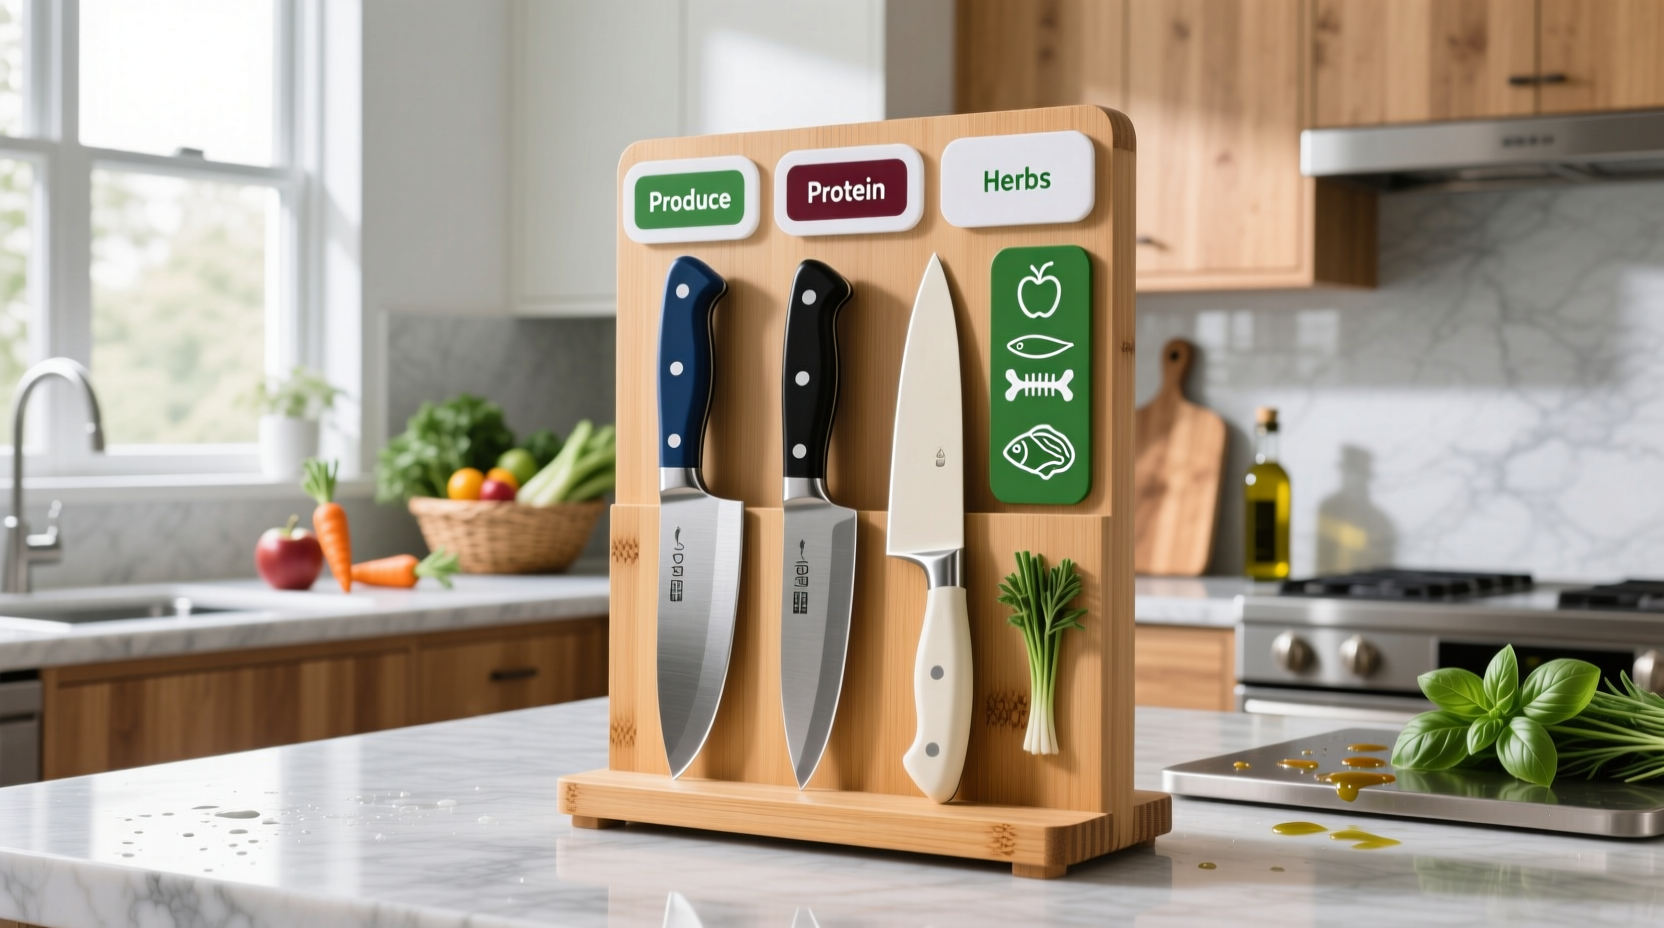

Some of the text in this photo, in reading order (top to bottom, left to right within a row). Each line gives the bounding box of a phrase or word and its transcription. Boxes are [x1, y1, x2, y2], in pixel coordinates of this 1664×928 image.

[807, 176, 886, 204] Protein
[984, 166, 1051, 192] Herbs
[649, 188, 732, 213] Produce
